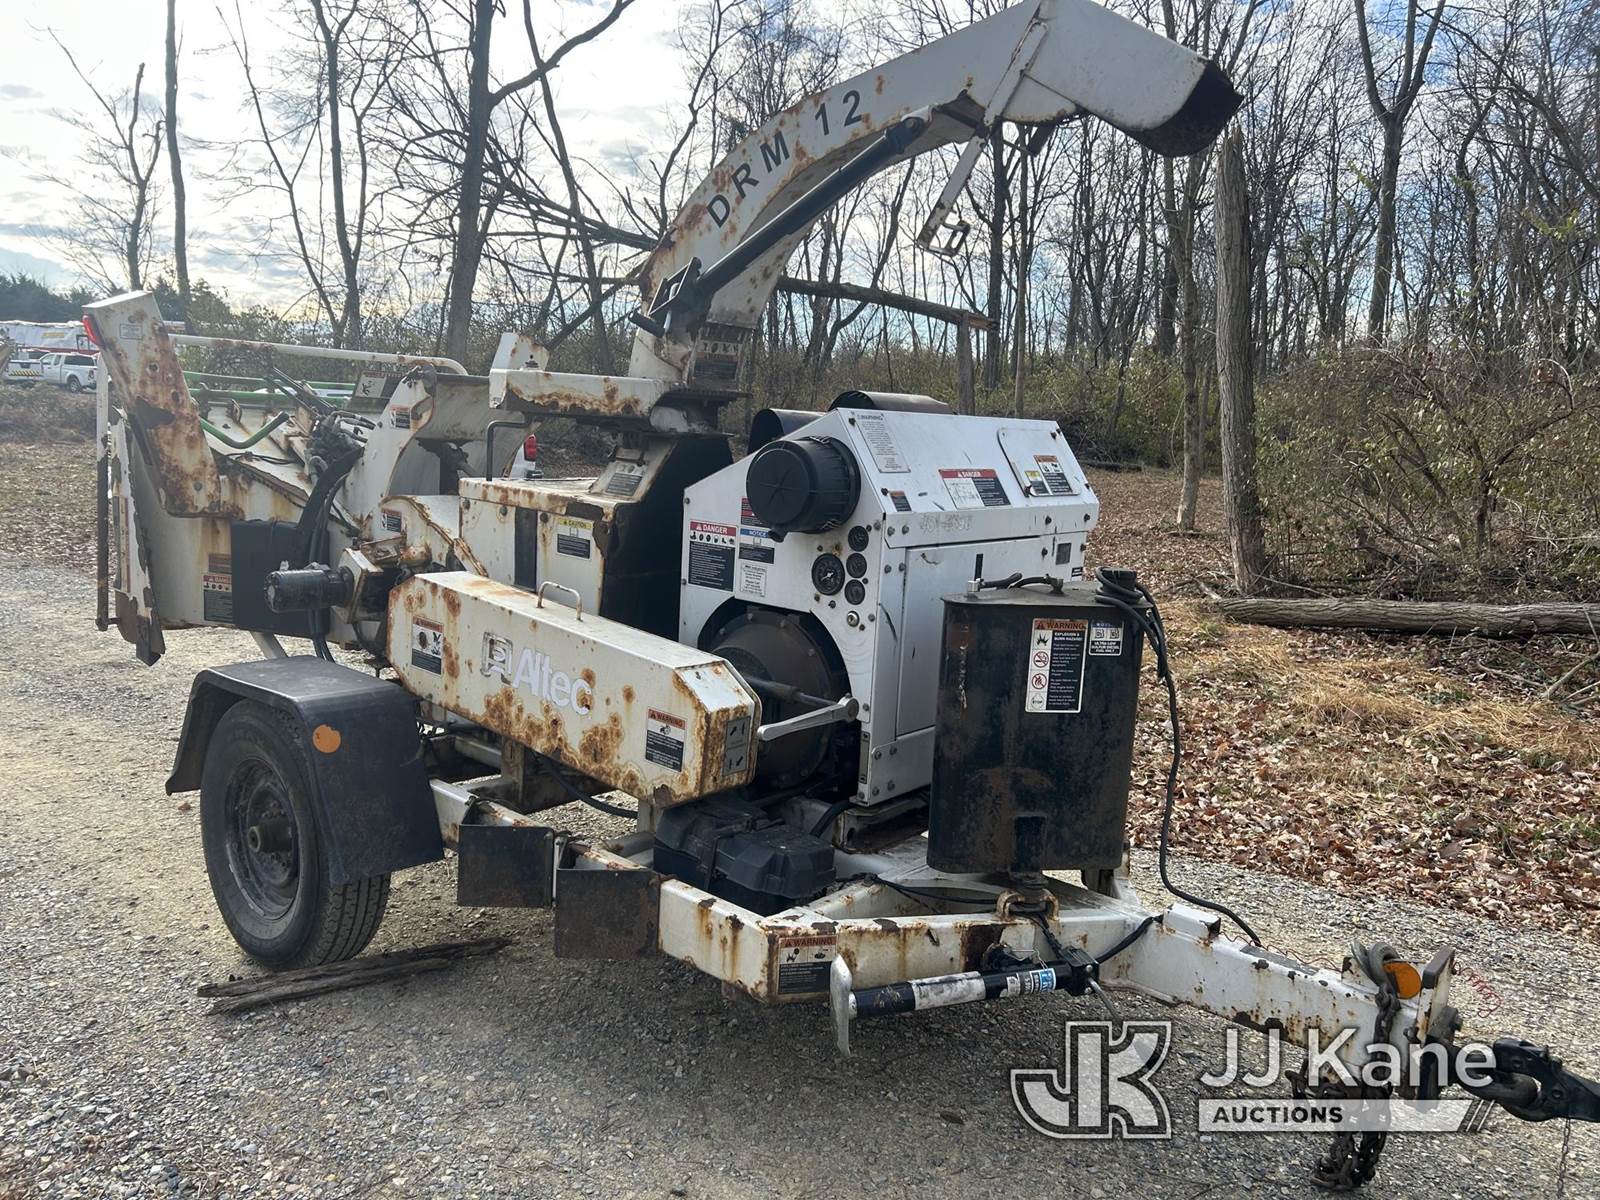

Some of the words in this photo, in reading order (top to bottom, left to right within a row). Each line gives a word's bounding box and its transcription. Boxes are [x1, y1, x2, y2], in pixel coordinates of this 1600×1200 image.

[706, 131, 790, 228] DRM
[815, 90, 862, 136] 12
[702, 524, 728, 534] DANGER
[1047, 621, 1084, 630] WARNING
[512, 647, 592, 715] Altec
[795, 937, 833, 946] WARNING
